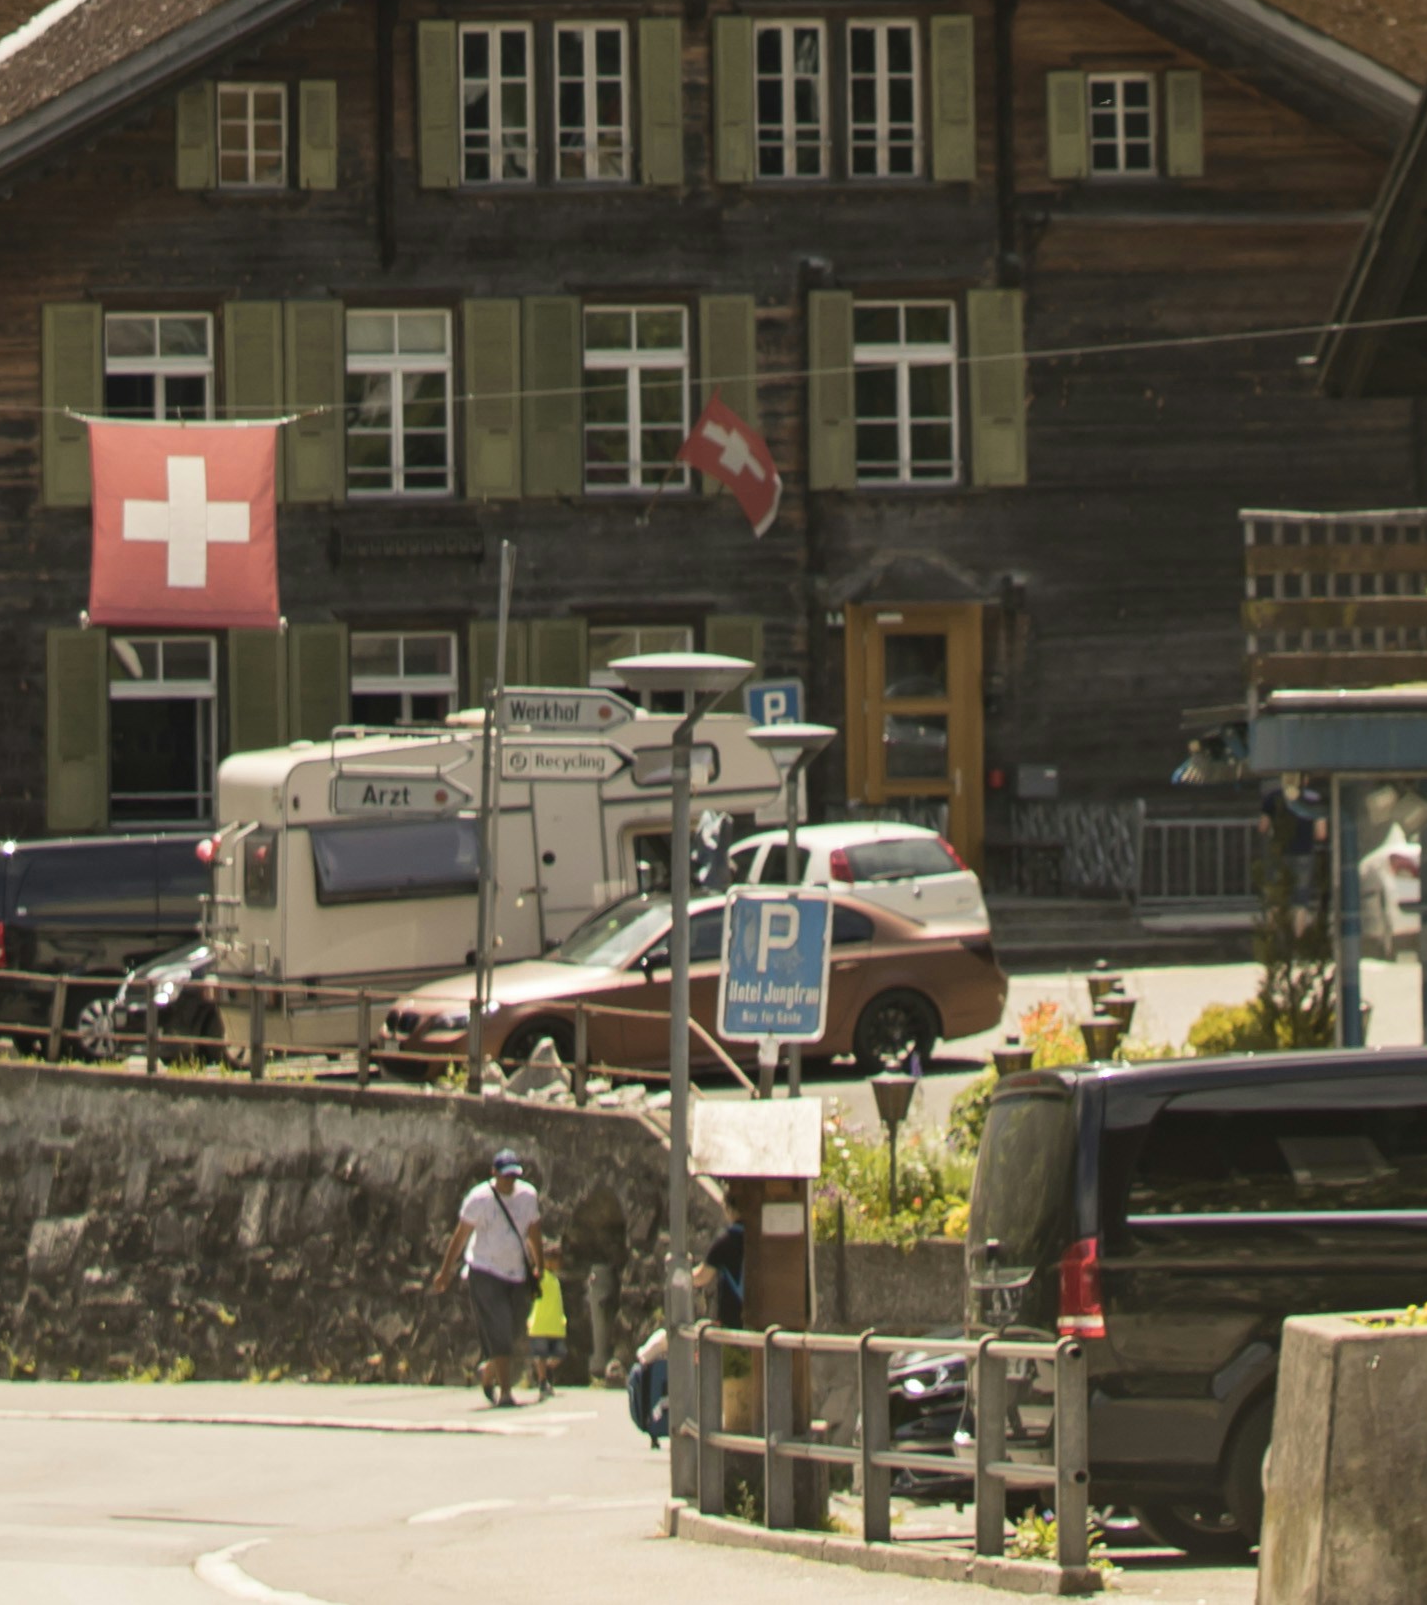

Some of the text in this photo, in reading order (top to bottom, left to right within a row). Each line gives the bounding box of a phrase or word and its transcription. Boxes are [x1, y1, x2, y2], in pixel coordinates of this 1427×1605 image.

[511, 700, 582, 723] Werkhof
[535, 753, 606, 772] Recycling
[362, 784, 411, 806] Arzt
[757, 903, 800, 973] P
[729, 980, 820, 1010] Hotel Jungfrau
